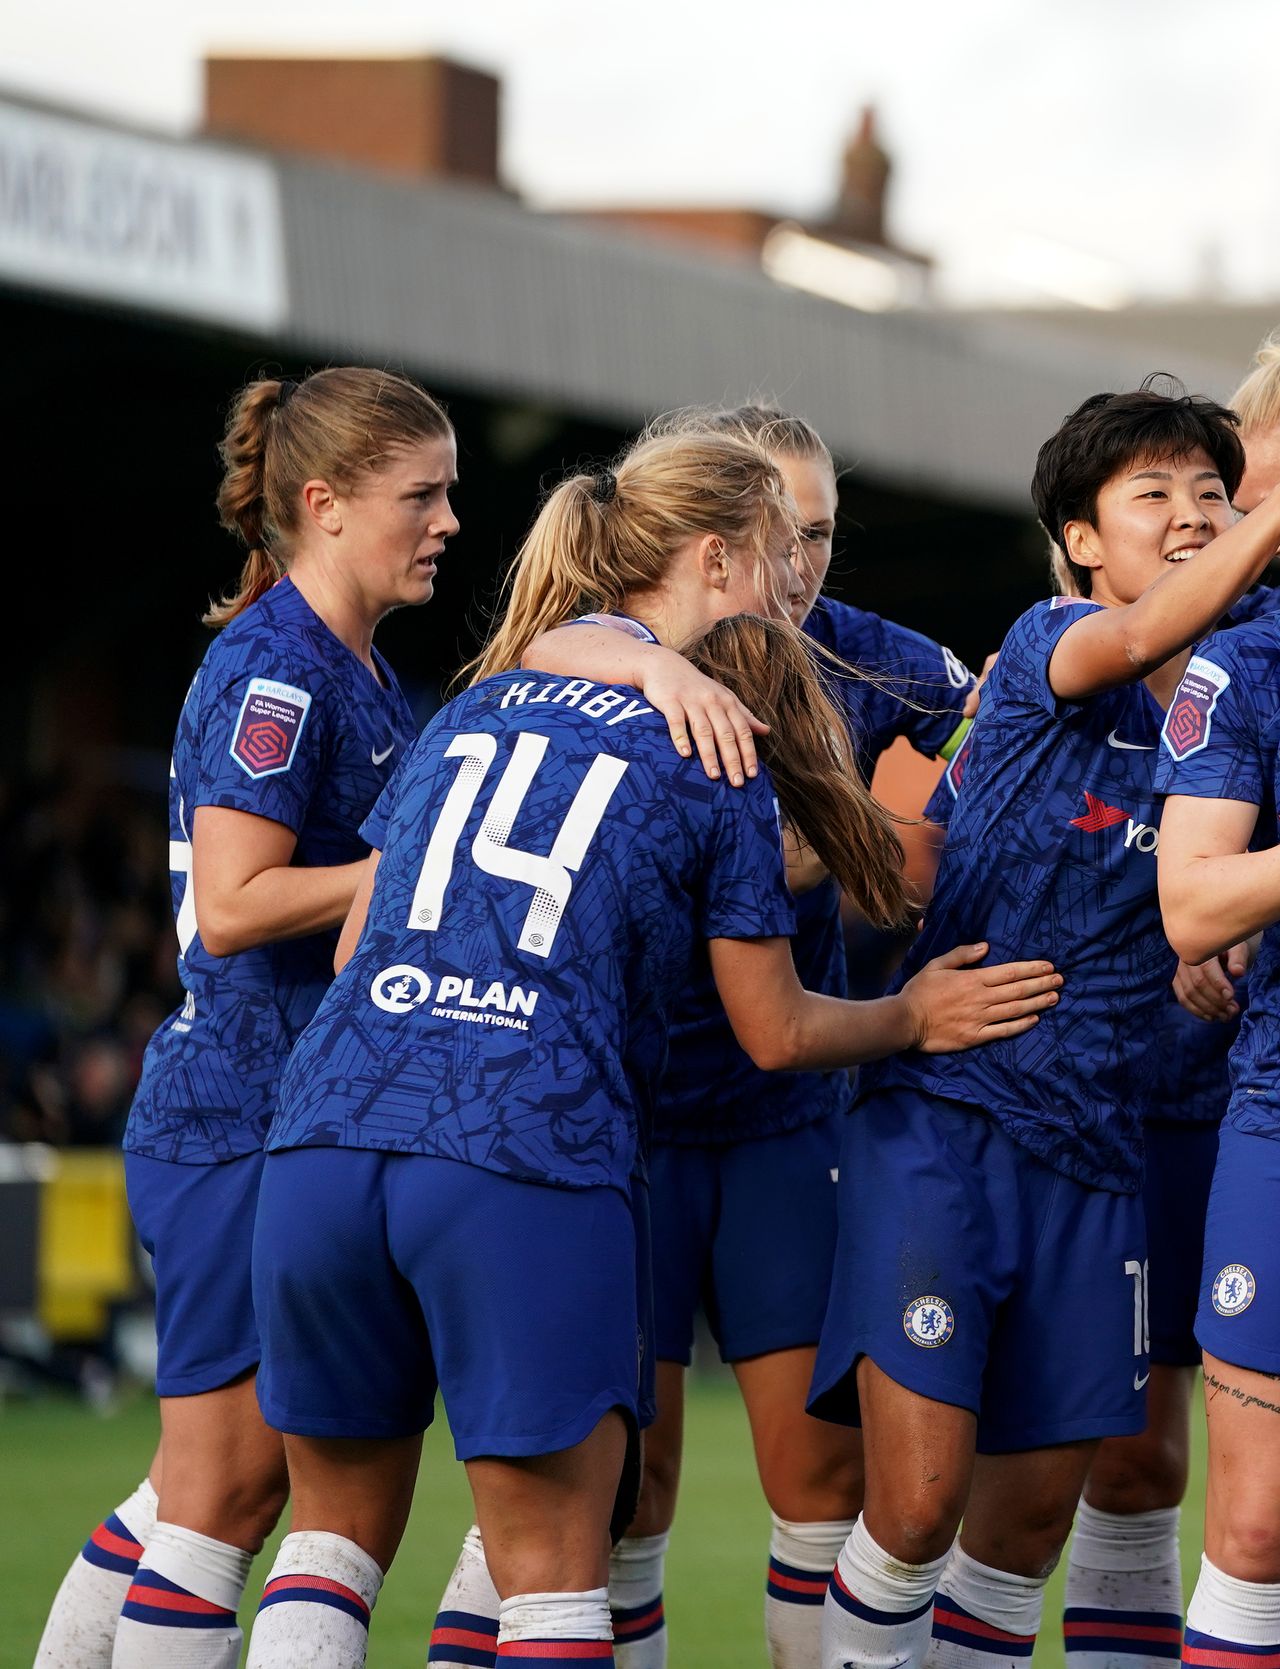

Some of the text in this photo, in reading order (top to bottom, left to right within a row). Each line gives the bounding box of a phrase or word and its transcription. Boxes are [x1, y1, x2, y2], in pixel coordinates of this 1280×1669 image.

[265, 685, 305, 702] BARCLAYS
[500, 679, 654, 727] KIRBY
[250, 704, 297, 725] Super League
[255, 699, 295, 718] FA Women's
[406, 731, 630, 959] 14
[1123, 818, 1159, 857] YO
[435, 975, 540, 1017] PLAN
[431, 1007, 530, 1031] INTERNATIONAL
[1220, 1266, 1248, 1278] CHELSEA
[914, 1297, 948, 1312] CHELSEA
